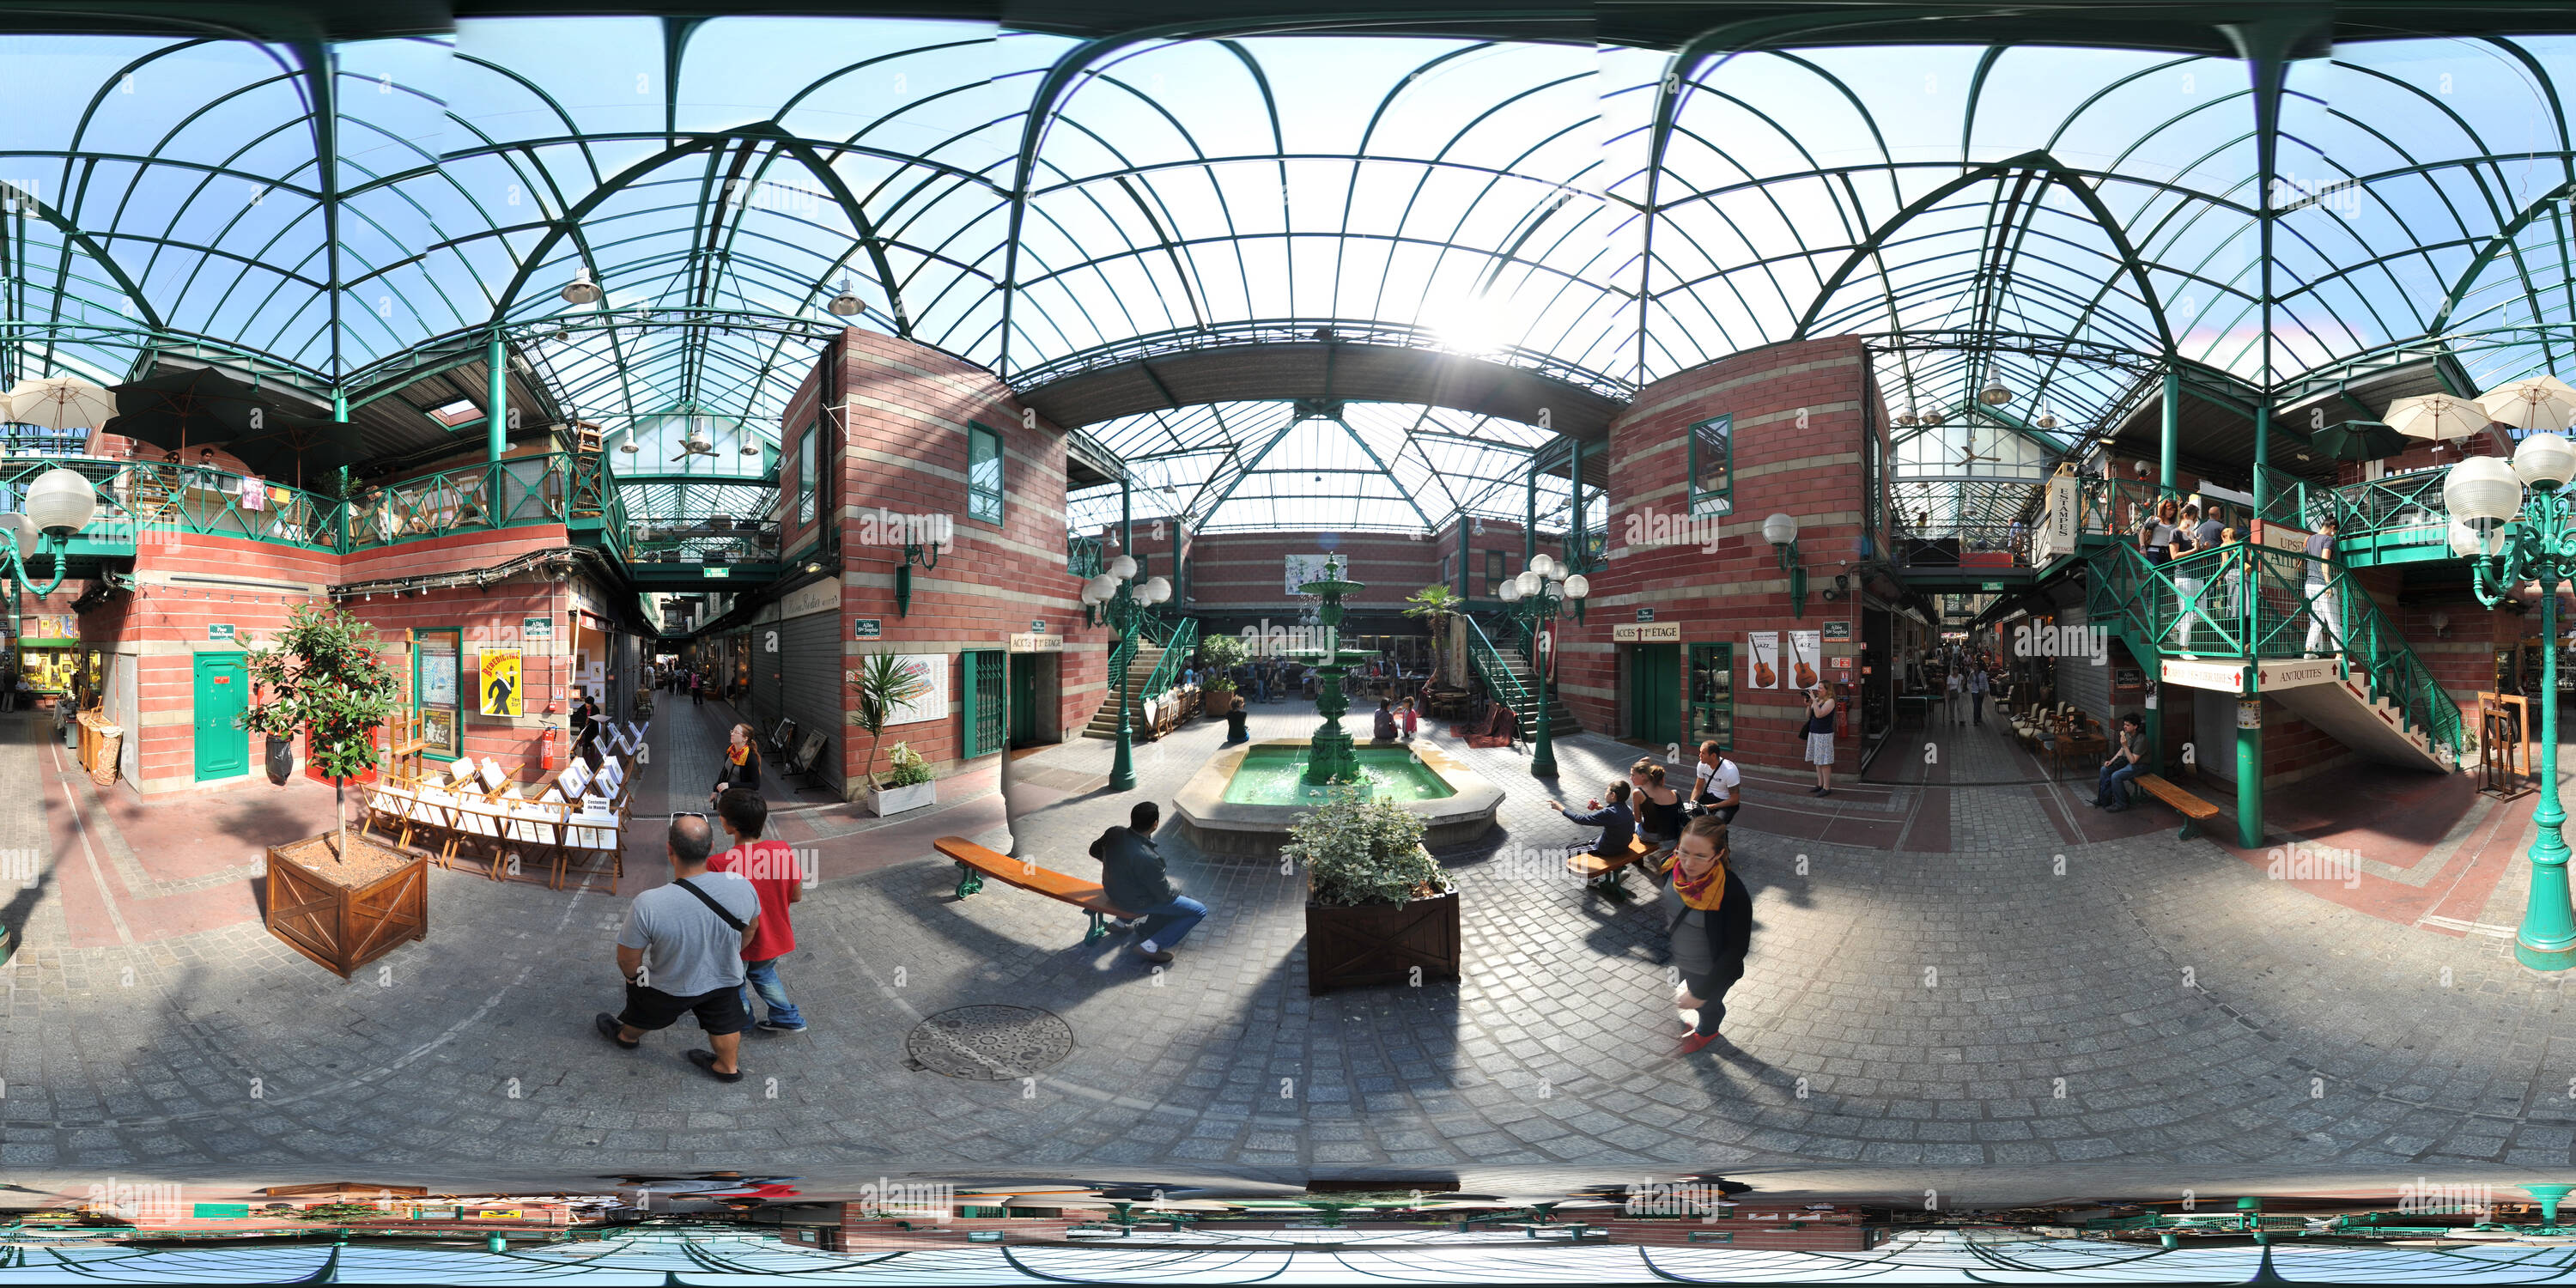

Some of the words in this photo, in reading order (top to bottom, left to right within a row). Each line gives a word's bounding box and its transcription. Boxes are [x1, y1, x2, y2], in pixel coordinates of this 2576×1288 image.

[2059, 489, 2069, 536] ESTAMPES
[1615, 629, 1635, 637] ACCÈS
[1652, 627, 1677, 637] ÉTAGE
